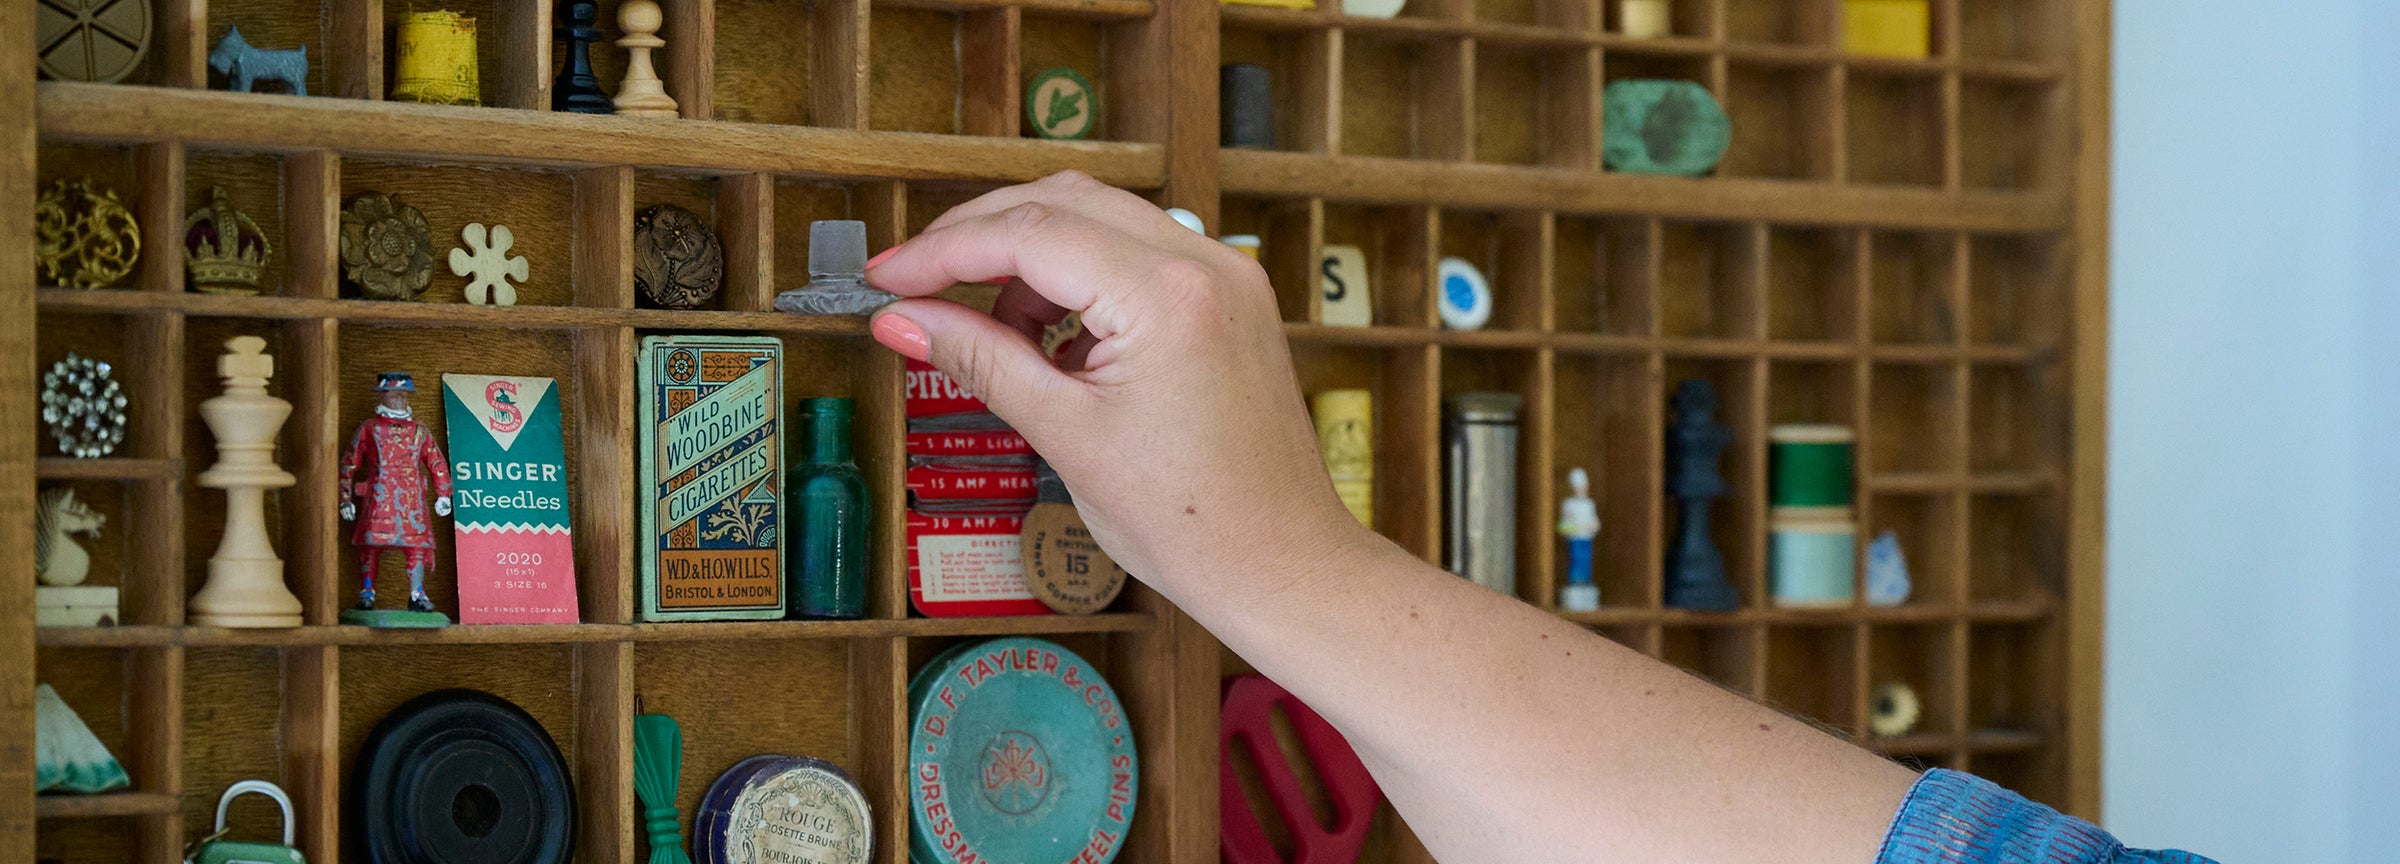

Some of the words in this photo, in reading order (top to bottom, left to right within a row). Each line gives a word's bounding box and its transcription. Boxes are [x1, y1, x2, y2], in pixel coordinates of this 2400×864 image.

[1321, 257, 1345, 301] S
[927, 438, 934, 449] 5
[669, 445, 767, 522] CIGARETTES
[931, 477, 946, 489] 15
[458, 490, 561, 510] Needles
[933, 517, 950, 529] 30
[496, 552, 542, 565] 2020
[1067, 553, 1089, 575] 15
[494, 581, 501, 589] 3
[506, 581, 533, 589] SIZE
[717, 589, 724, 598] &
[958, 649, 1059, 688] TAYLER
[1063, 666, 1084, 691] &
[919, 764, 988, 864] DRESSM
[1106, 754, 1131, 823] PINS
[780, 807, 837, 834] ROUGE
[765, 823, 806, 842] ROSETTE
[807, 834, 842, 851] BRUNE
